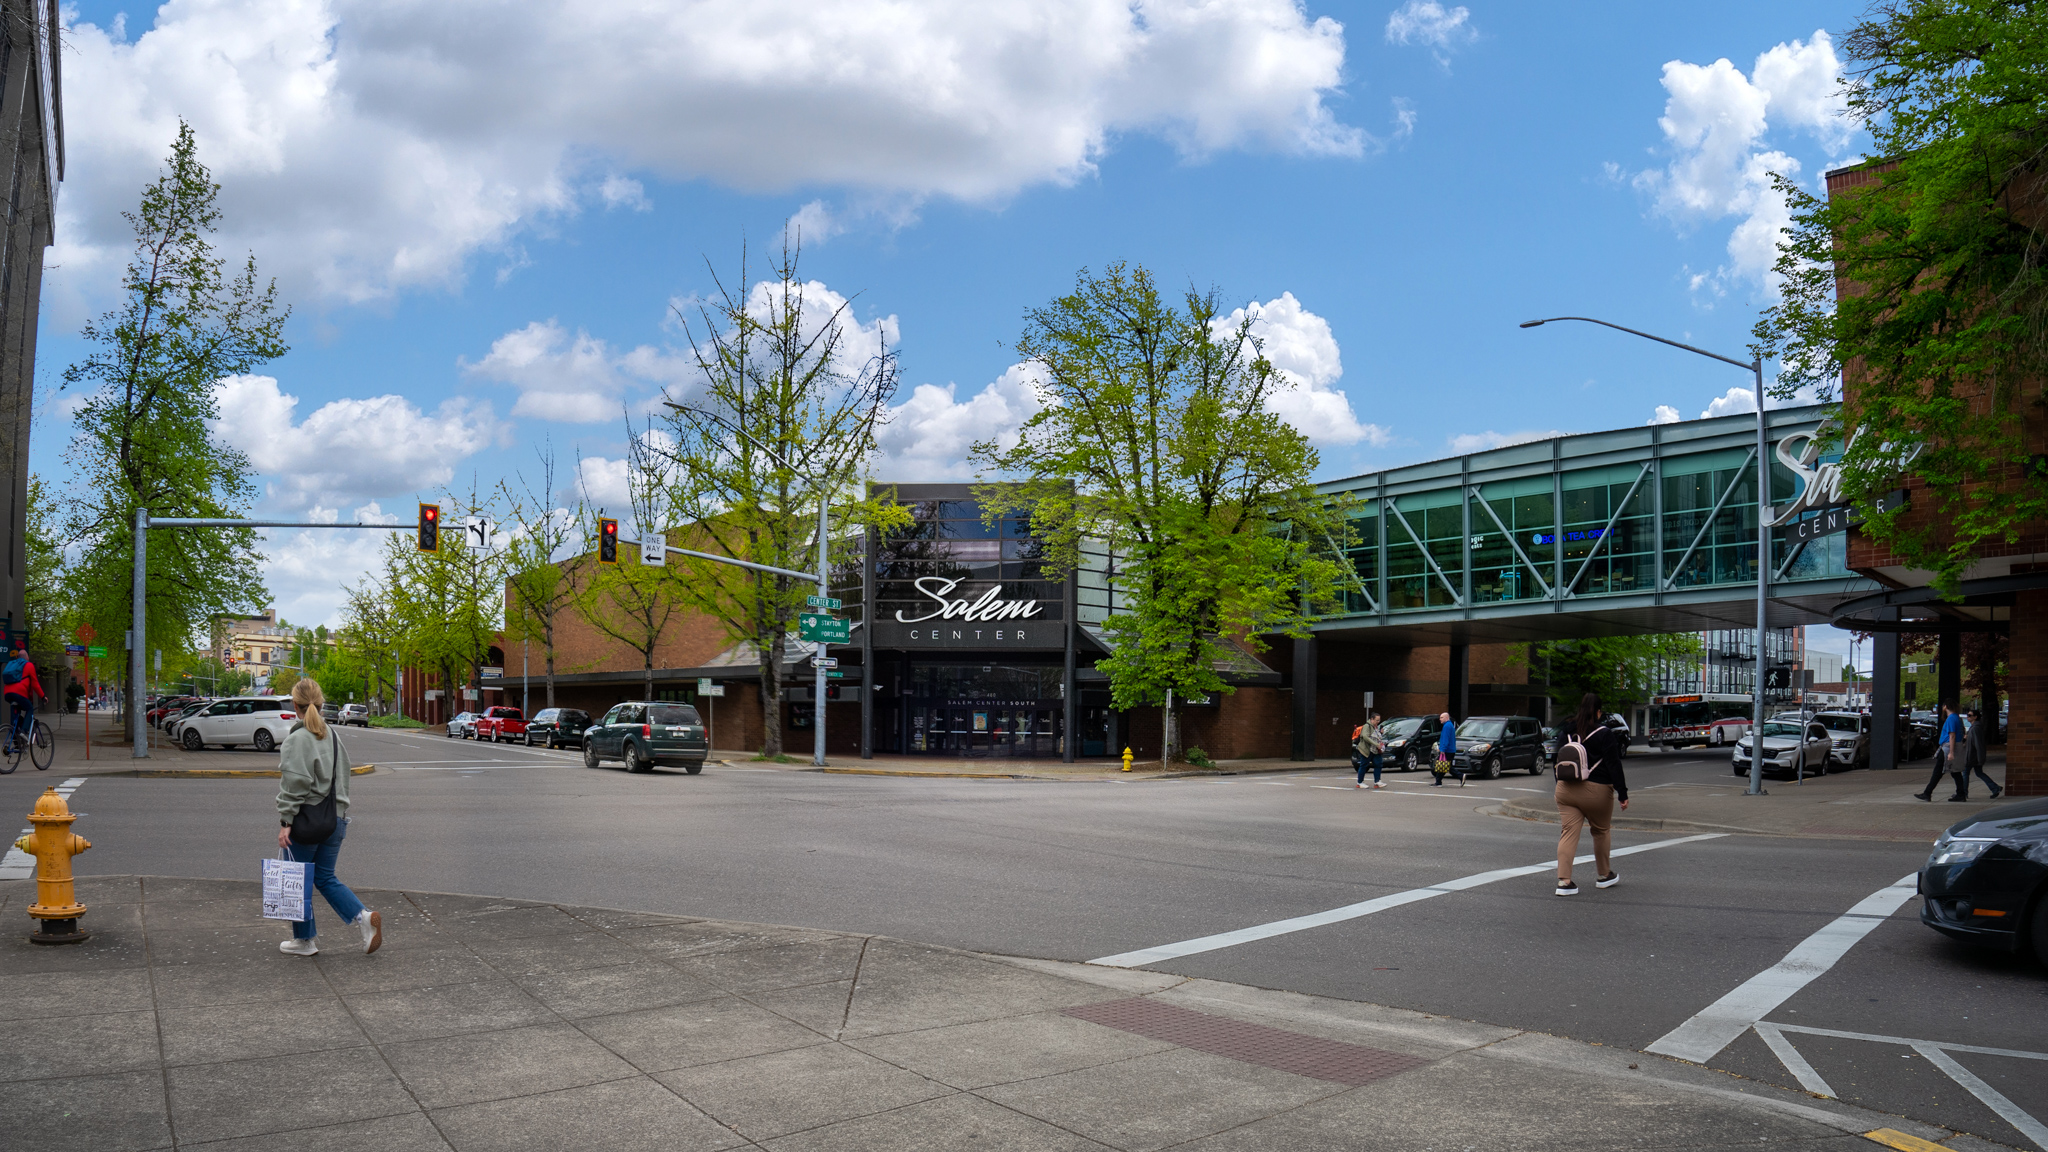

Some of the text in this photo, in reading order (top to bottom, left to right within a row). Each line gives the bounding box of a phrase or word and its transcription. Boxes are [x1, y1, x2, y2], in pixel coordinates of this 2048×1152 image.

[1799, 499, 1885, 538] CENTR
[646, 536, 661, 544] ONE
[1568, 531, 1585, 541] TEA
[646, 544, 661, 552] WAY
[810, 597, 839, 608] CENTER ST
[895, 576, 1043, 623] Salem
[910, 630, 1026, 640] CENTER
[285, 880, 303, 890] Gifts
[264, 901, 278, 912] trip
